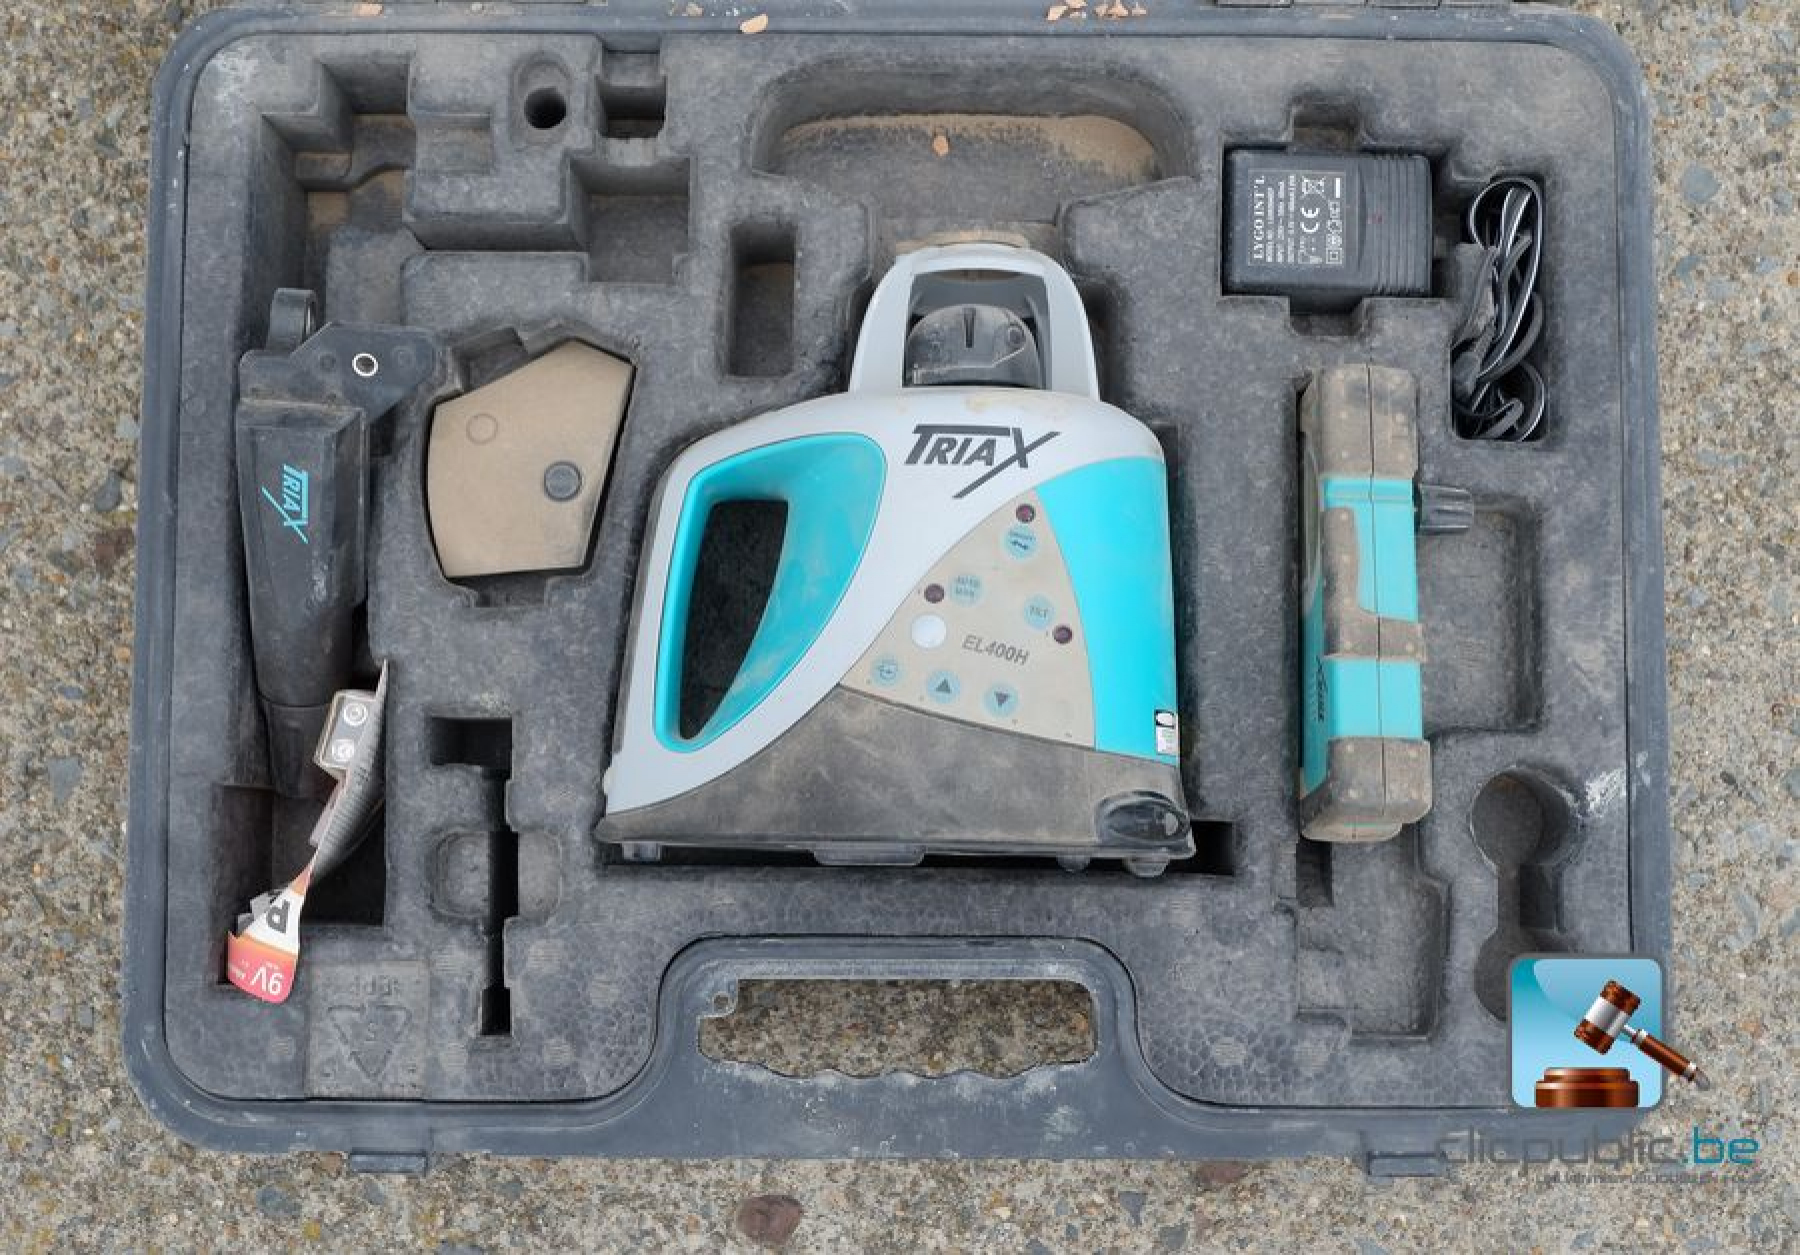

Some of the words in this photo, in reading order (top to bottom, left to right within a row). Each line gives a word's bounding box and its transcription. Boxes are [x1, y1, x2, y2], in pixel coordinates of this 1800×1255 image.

[1253, 175, 1265, 217] INT'L
[1253, 219, 1265, 259] LYGO
[905, 423, 1061, 499] TRIAX
[261, 463, 309, 545] TRIAX
[962, 634, 1030, 665] EL400H
[249, 965, 282, 996] 9V
